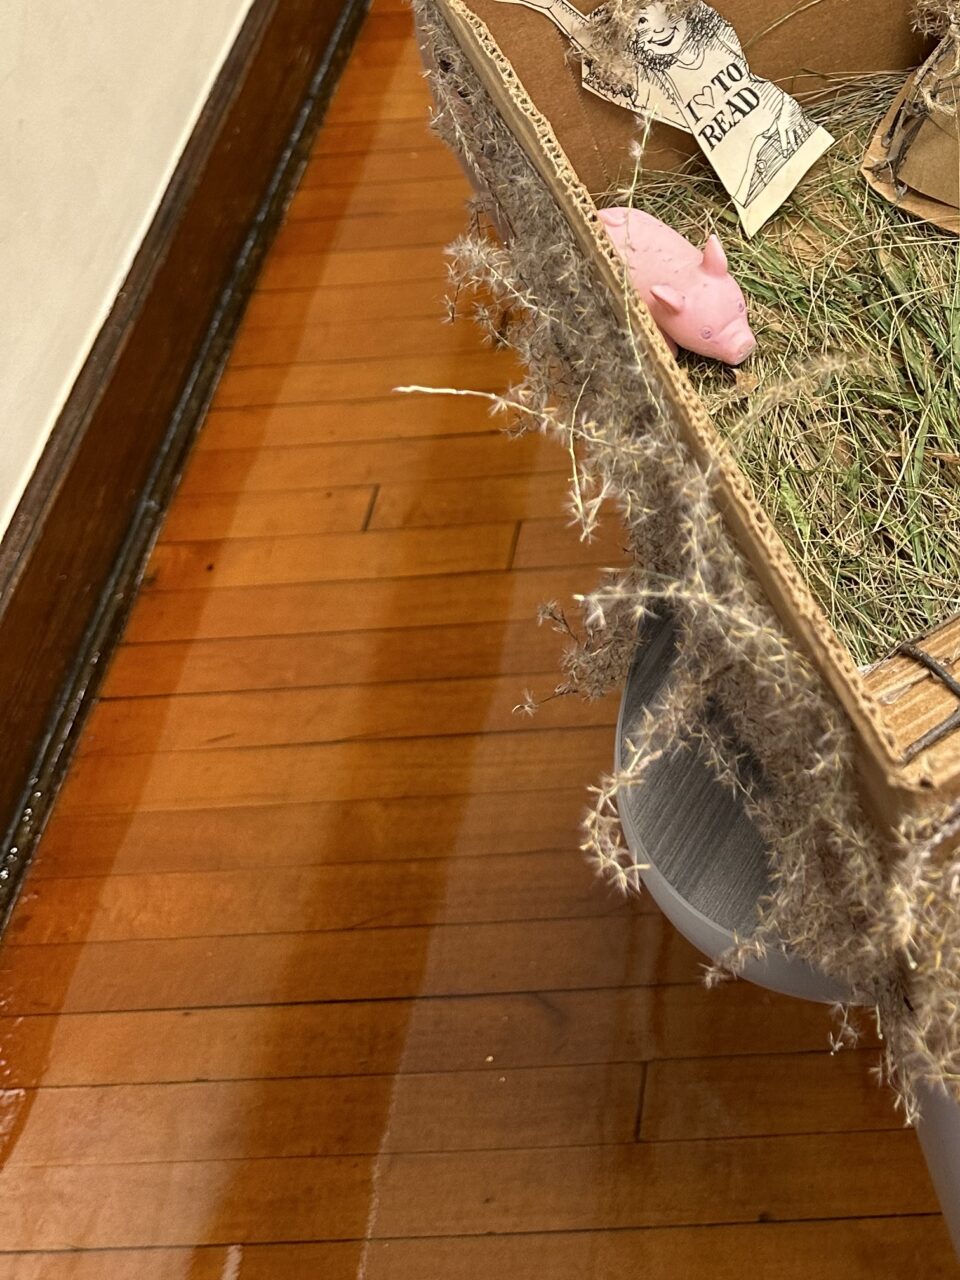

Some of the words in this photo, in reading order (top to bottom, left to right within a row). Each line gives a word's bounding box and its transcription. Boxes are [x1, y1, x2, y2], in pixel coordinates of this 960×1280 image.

[684, 100, 702, 126] I
[711, 62, 745, 94] TO
[698, 85, 761, 152] READ
